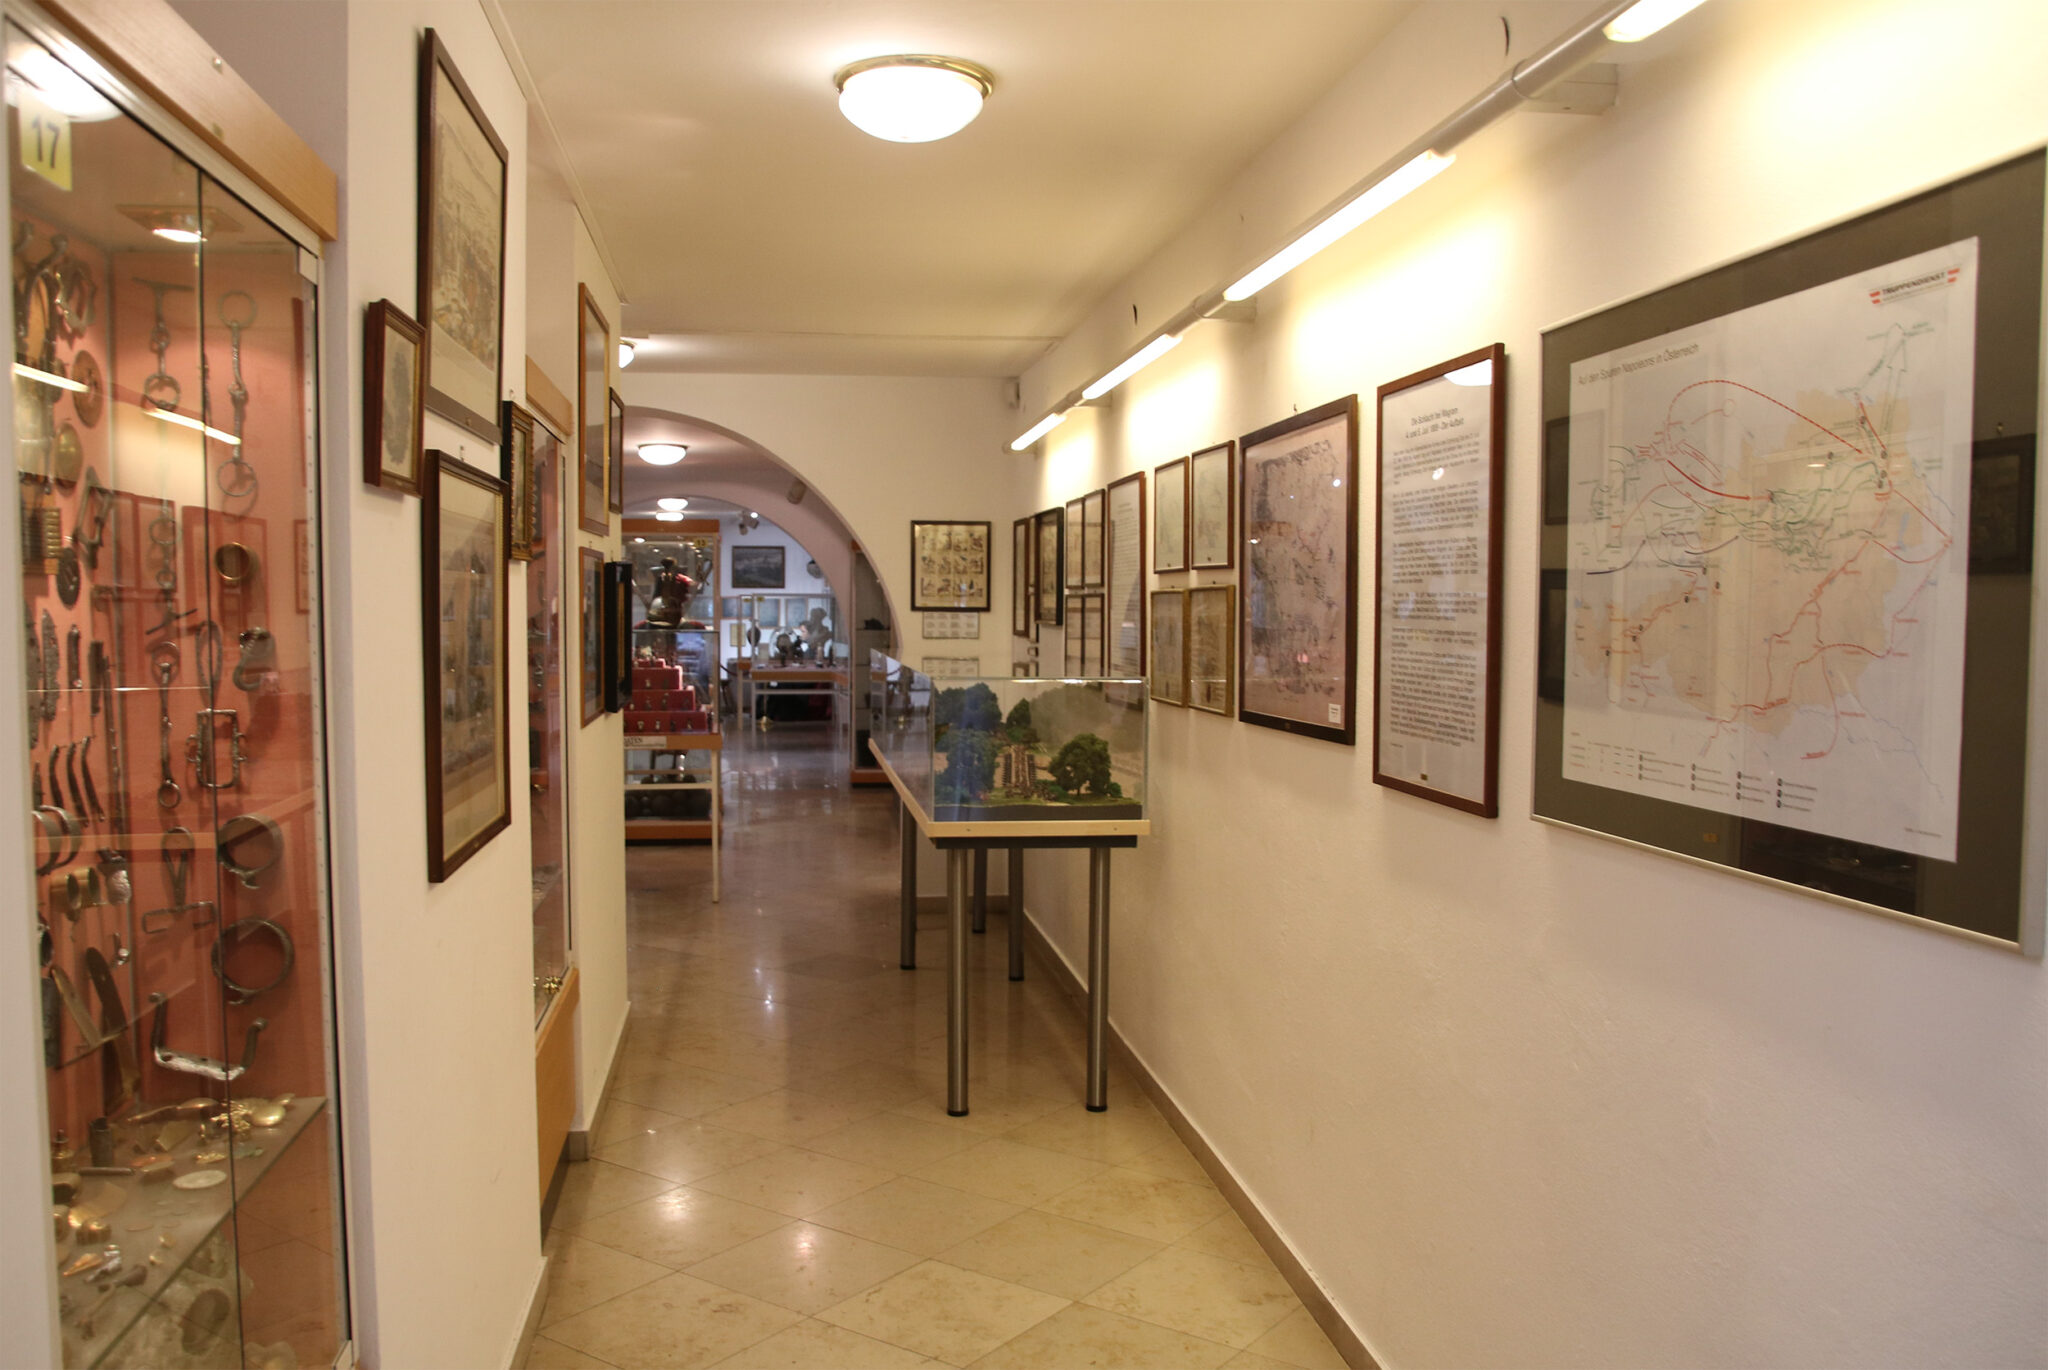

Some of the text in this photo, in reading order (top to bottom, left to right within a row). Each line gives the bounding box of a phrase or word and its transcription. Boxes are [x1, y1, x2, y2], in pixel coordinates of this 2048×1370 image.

[31, 113, 60, 169] 17
[1882, 271, 1945, 295] TRUPPENDIENST
[1601, 366, 1621, 380] Spuren
[1664, 343, 1699, 362] Österreich
